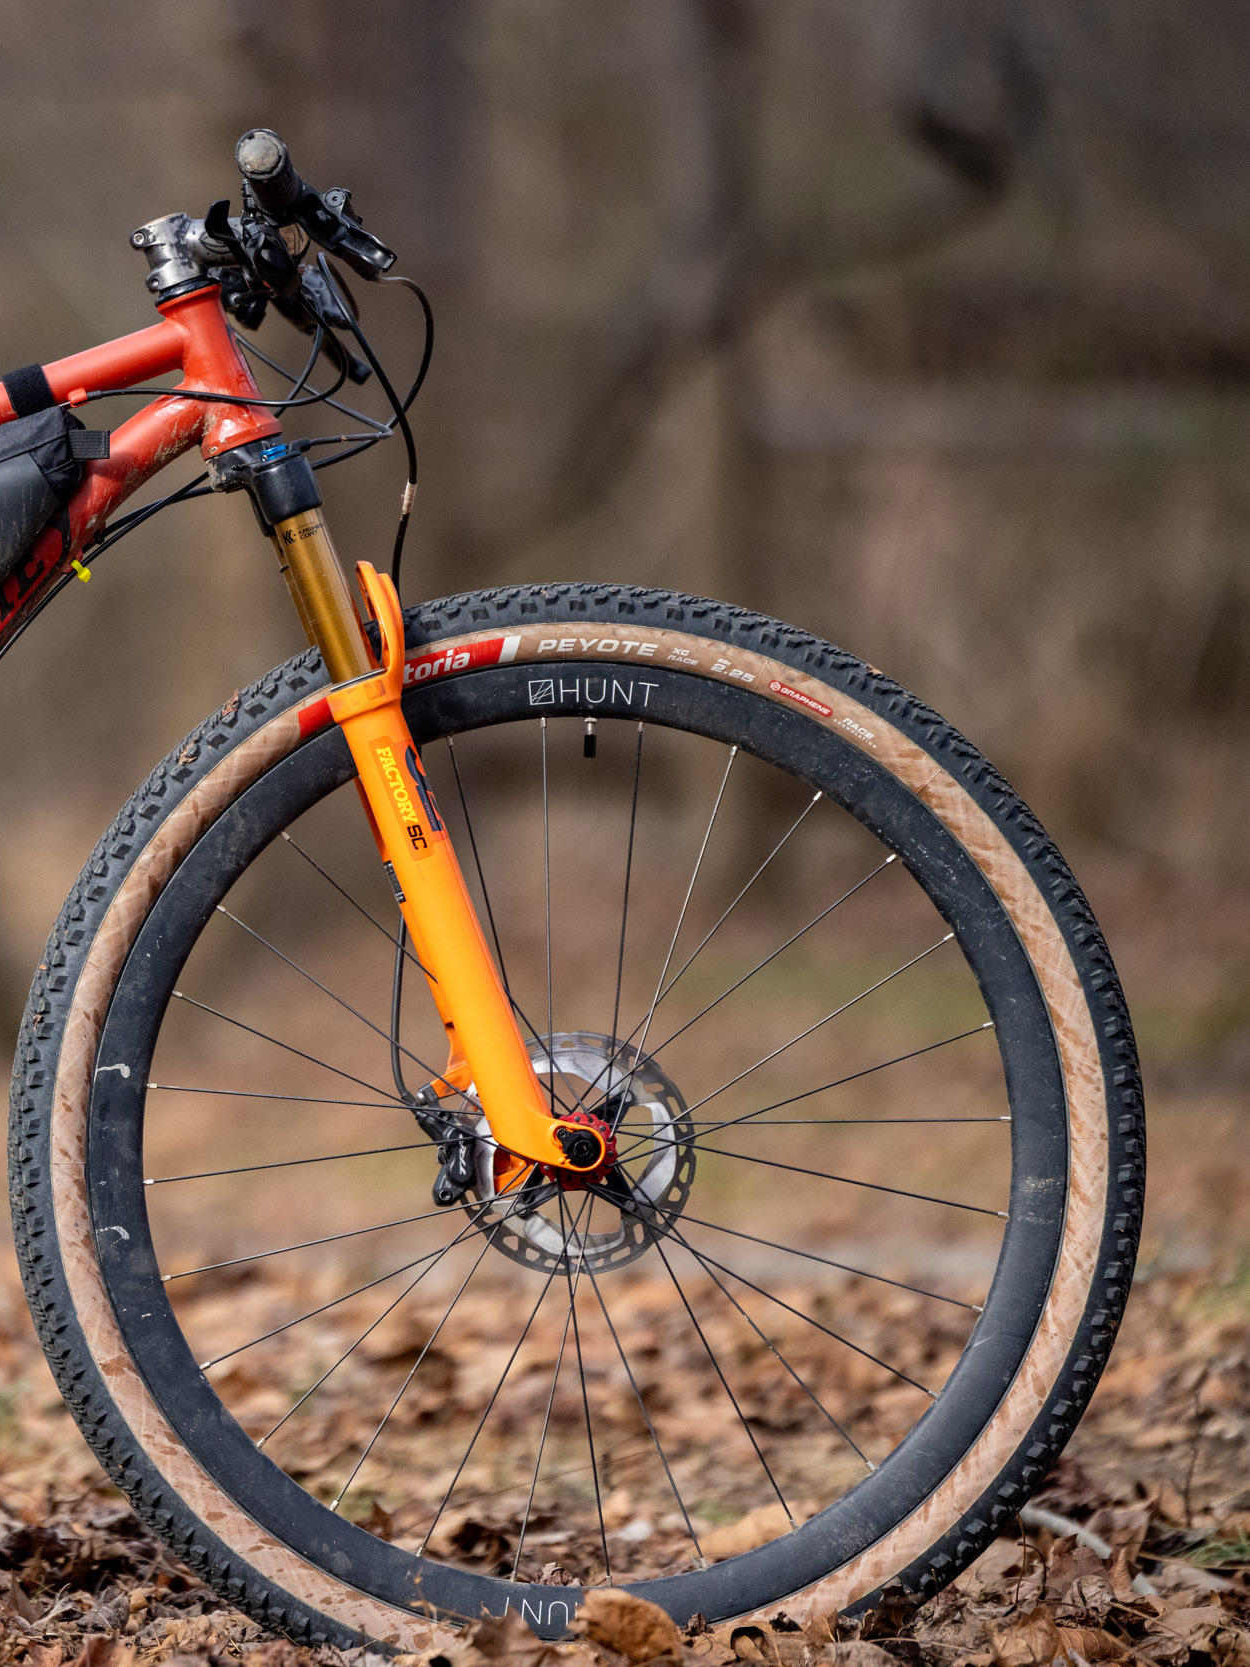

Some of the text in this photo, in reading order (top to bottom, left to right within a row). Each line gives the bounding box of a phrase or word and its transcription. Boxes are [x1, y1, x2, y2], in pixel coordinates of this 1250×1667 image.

[537, 638, 659, 657] PEYOTE
[673, 647, 691, 657] XC
[403, 649, 470, 685] toria
[667, 655, 700, 666] RACE
[710, 663, 756, 684] 2.25
[560, 678, 660, 707] HUNT
[780, 687, 831, 715] GRAPHENE
[833, 718, 878, 749] FORMULATION
[842, 718, 875, 740] RACE
[376, 746, 419, 823] FACTORY
[407, 824, 428, 851] SC
